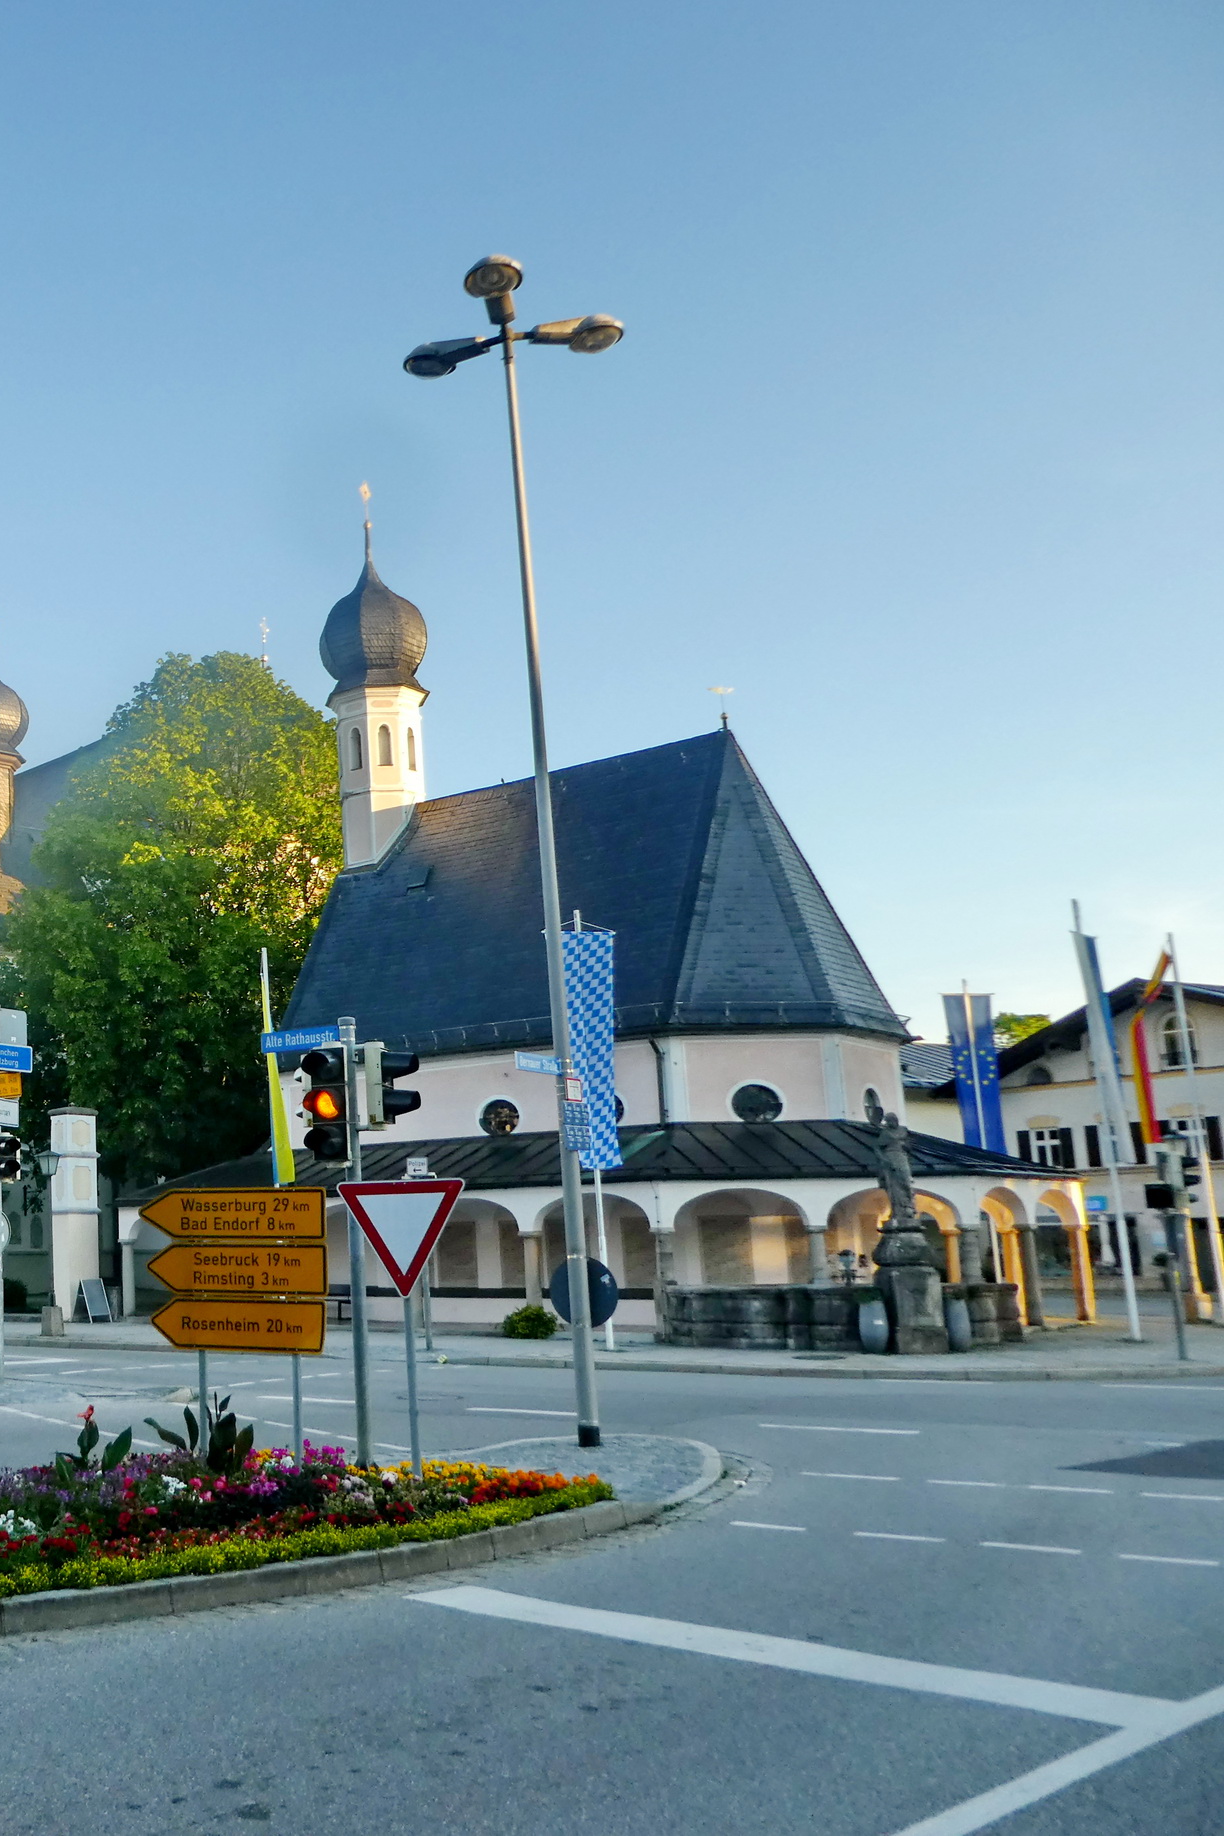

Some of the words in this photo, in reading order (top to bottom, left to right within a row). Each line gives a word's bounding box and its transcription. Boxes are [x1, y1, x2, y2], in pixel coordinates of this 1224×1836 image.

[265, 1035, 282, 1048] Alte
[285, 1030, 336, 1046] Rathausstr.
[180, 1197, 266, 1215] Wasserburg
[273, 1197, 289, 1212] 29
[292, 1201, 310, 1212] km
[180, 1216, 207, 1230] Bad
[213, 1217, 260, 1231] Endorf
[267, 1217, 275, 1231] 8
[278, 1220, 296, 1231] km
[193, 1252, 259, 1267] Seebruck
[266, 1252, 280, 1267] 19
[283, 1256, 301, 1267] km
[193, 1271, 255, 1288] Rimsting
[261, 1272, 269, 1286] 3
[272, 1275, 289, 1286] km
[181, 1316, 260, 1332] Rosenheim
[266, 1319, 283, 1333] 20
[286, 1323, 303, 1334] km
